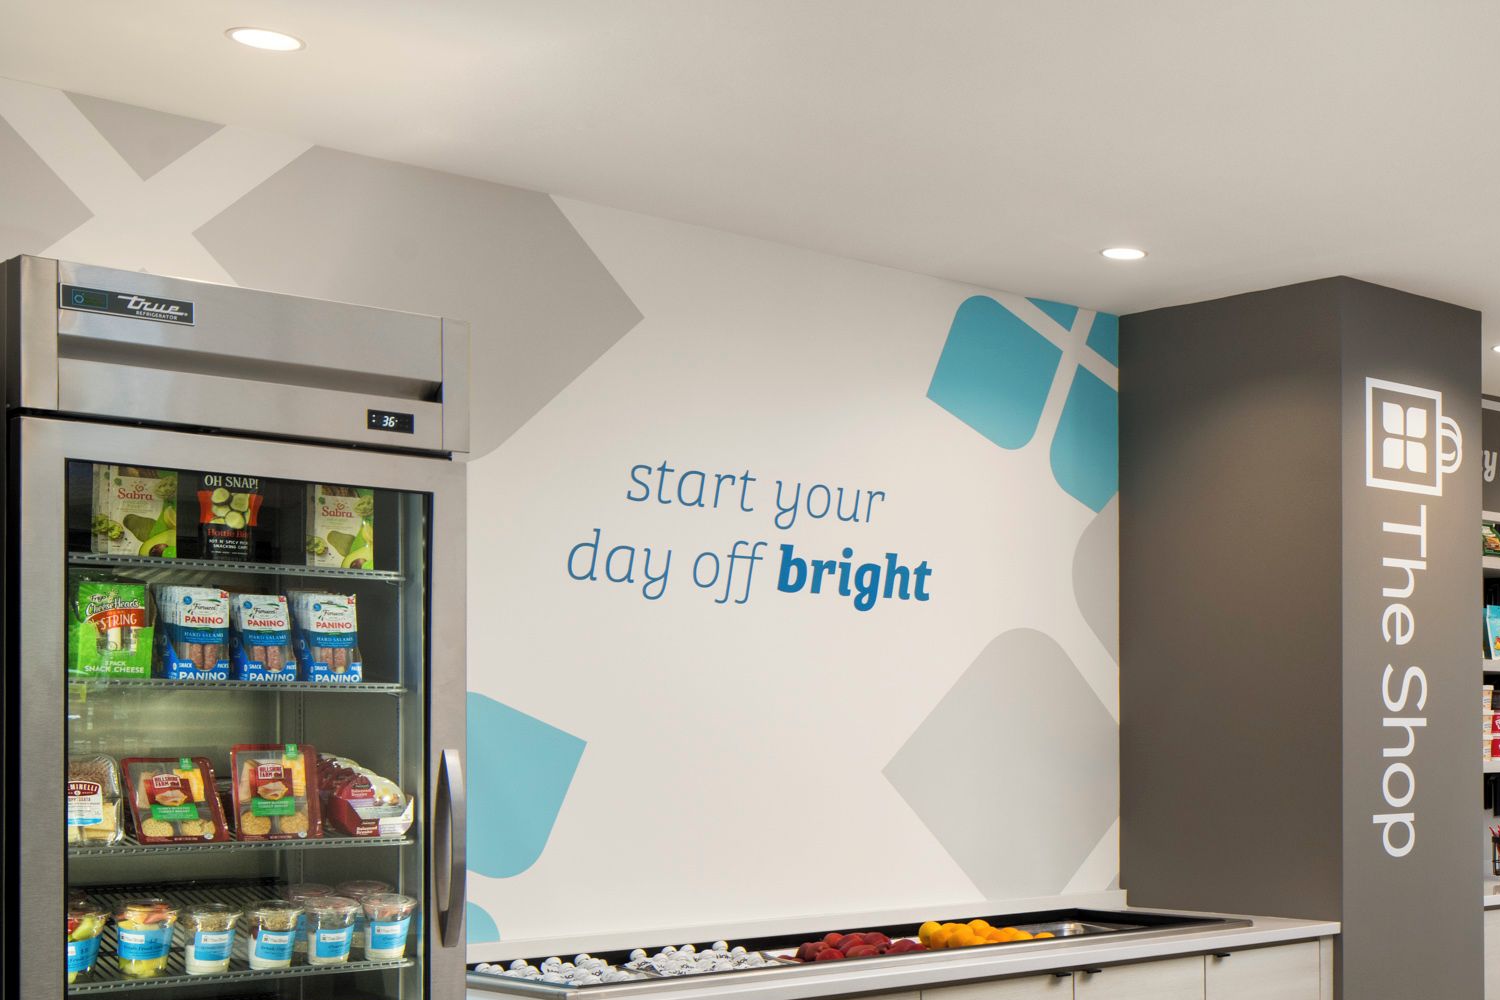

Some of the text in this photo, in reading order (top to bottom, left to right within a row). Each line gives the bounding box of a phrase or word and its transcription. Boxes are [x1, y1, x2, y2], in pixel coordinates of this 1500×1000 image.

[135, 310, 178, 321] REFRIGERATOR
[381, 415, 396, 428] 36
[204, 474, 259, 490] OH SNAP!
[117, 487, 154, 502] Sabra
[626, 460, 886, 530] start your
[321, 505, 354, 519] Sabra
[567, 528, 932, 612] day off bright
[99, 612, 138, 631] STRING
[184, 615, 224, 625] PANINO
[247, 619, 285, 628] PANINO
[315, 621, 353, 629] PANINO
[84, 665, 145, 675] SNACK CHEESE
[179, 671, 227, 681] PANINO
[249, 673, 295, 681] PANINO
[315, 674, 360, 683] PANINO
[1372, 504, 1428, 858] The Shop
[68, 783, 98, 792] MINELLI
